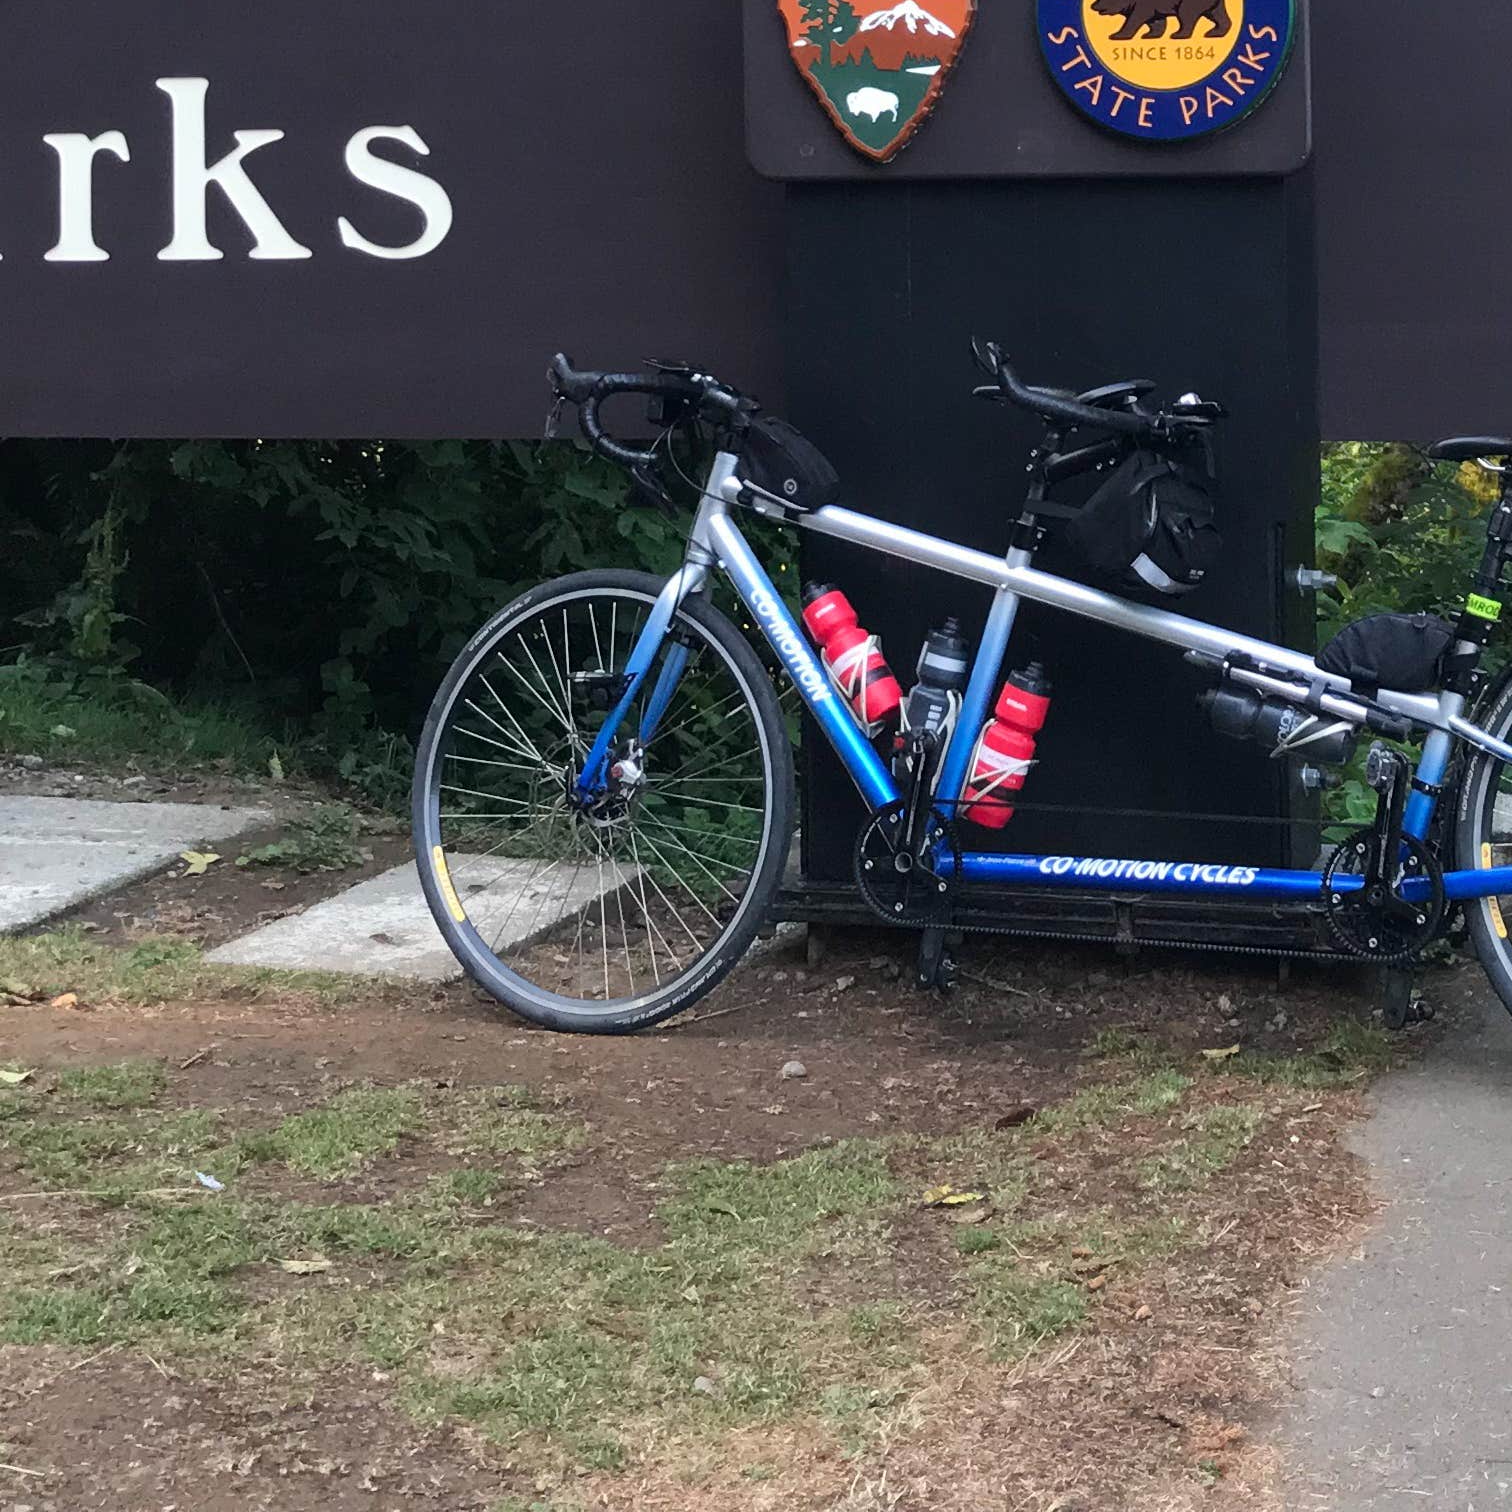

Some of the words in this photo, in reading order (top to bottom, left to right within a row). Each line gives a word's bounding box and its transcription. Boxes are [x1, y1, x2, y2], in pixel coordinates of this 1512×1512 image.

[1047, 26, 1156, 128] STATE
[1178, 23, 1278, 125] PARKS
[1112, 46, 1168, 61] SINCE
[1175, 45, 1216, 61] 1864
[0, 76, 453, 262] rks
[1173, 863, 1260, 885] CYCLES
